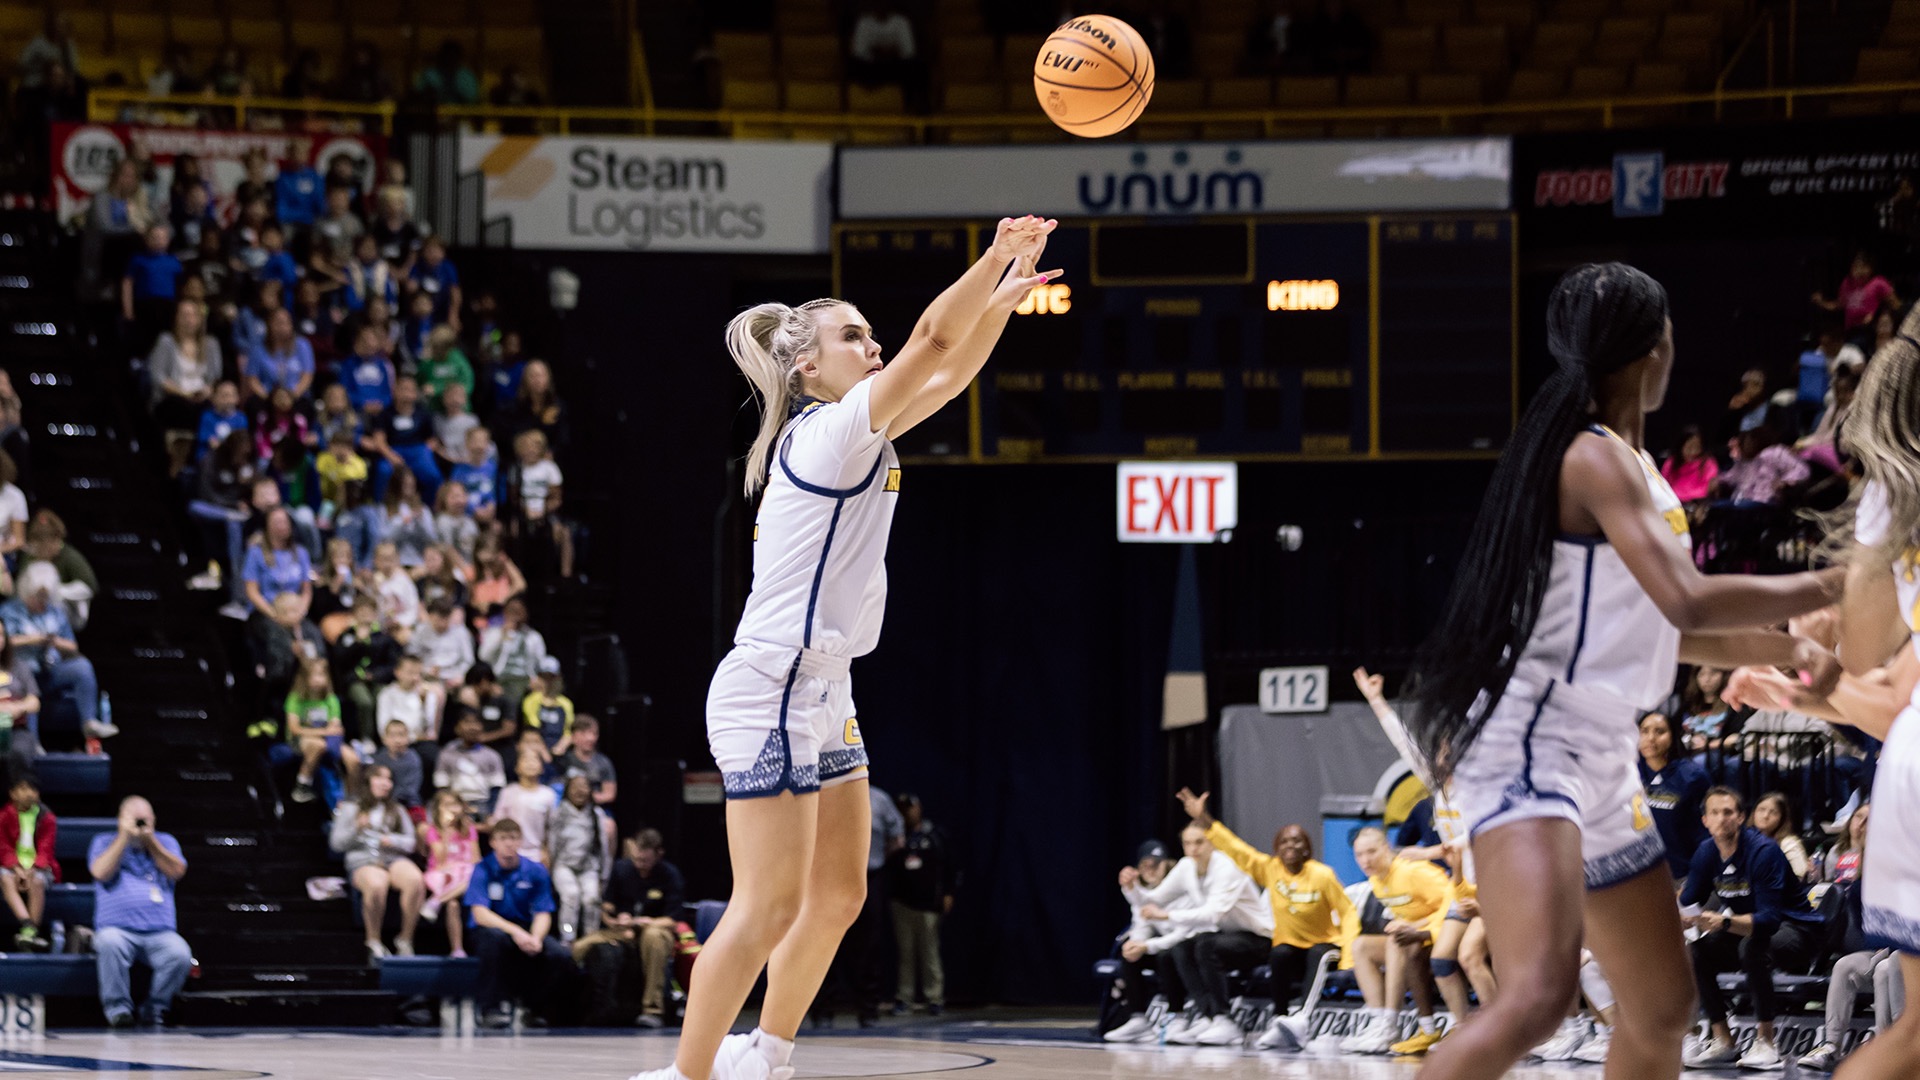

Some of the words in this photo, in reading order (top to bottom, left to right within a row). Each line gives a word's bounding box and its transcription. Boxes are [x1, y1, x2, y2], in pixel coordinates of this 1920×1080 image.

[571, 144, 726, 192] Steam
[1534, 168, 1612, 207] FOOD
[1663, 160, 1729, 199] CITY
[1740, 155, 1810, 178] OFFICIAL
[1770, 177, 1792, 196] OF
[568, 193, 766, 250] Logistics
[1127, 476, 1223, 532] EXIT
[1267, 673, 1318, 706] 112
